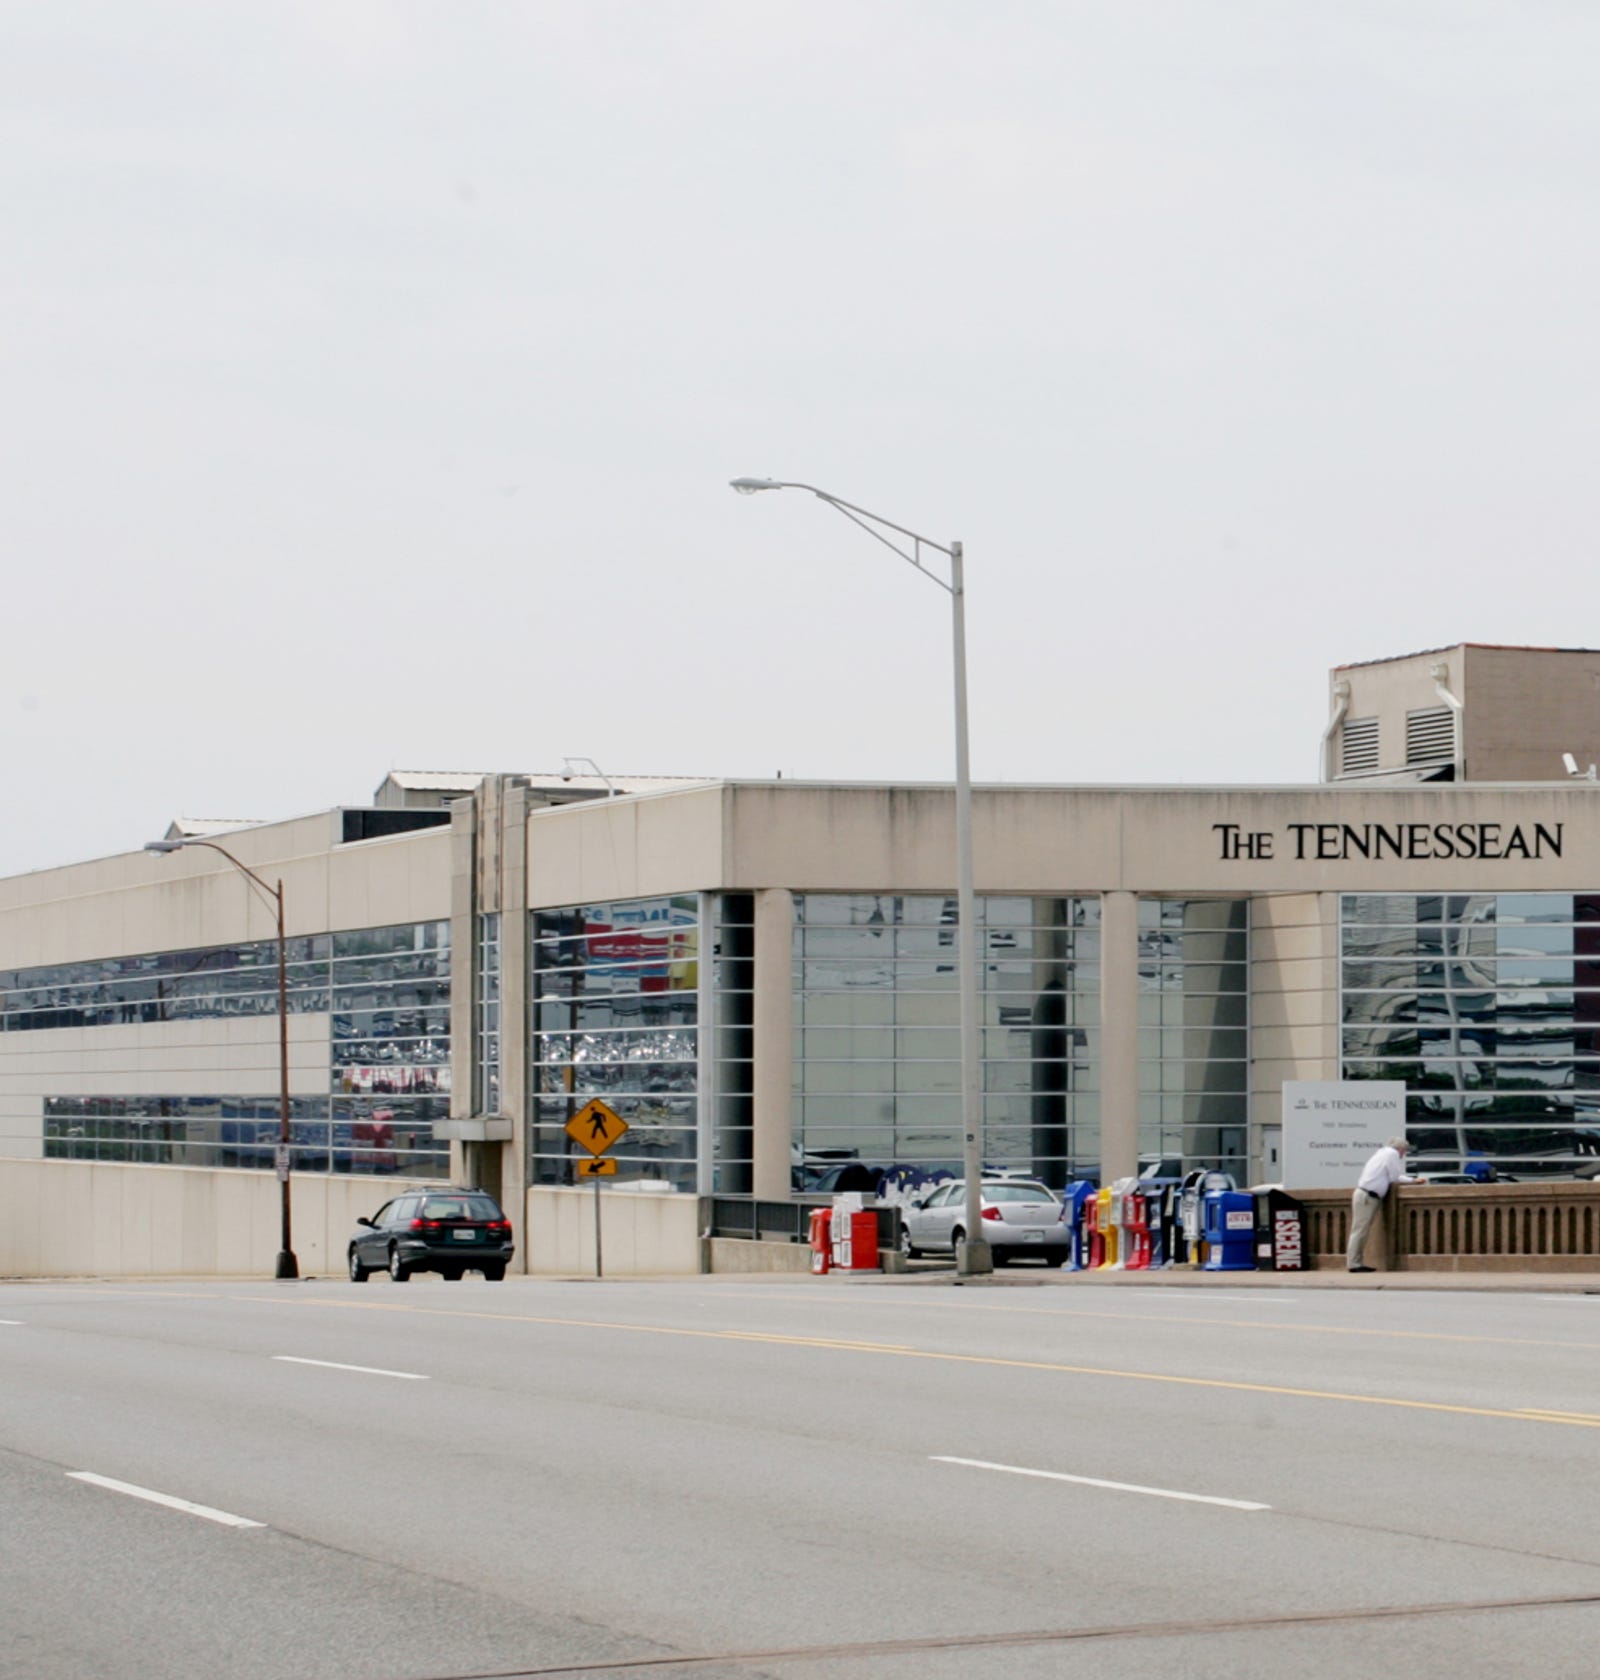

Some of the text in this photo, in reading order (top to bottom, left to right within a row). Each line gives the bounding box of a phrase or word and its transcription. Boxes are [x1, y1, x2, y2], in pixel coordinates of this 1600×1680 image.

[1212, 823, 1565, 860] THE TENNESSEAN
[1331, 1100, 1397, 1110] TENNESSEAN
[1309, 1141, 1348, 1149] Customer
[1275, 1221, 1301, 1269] SCENE
